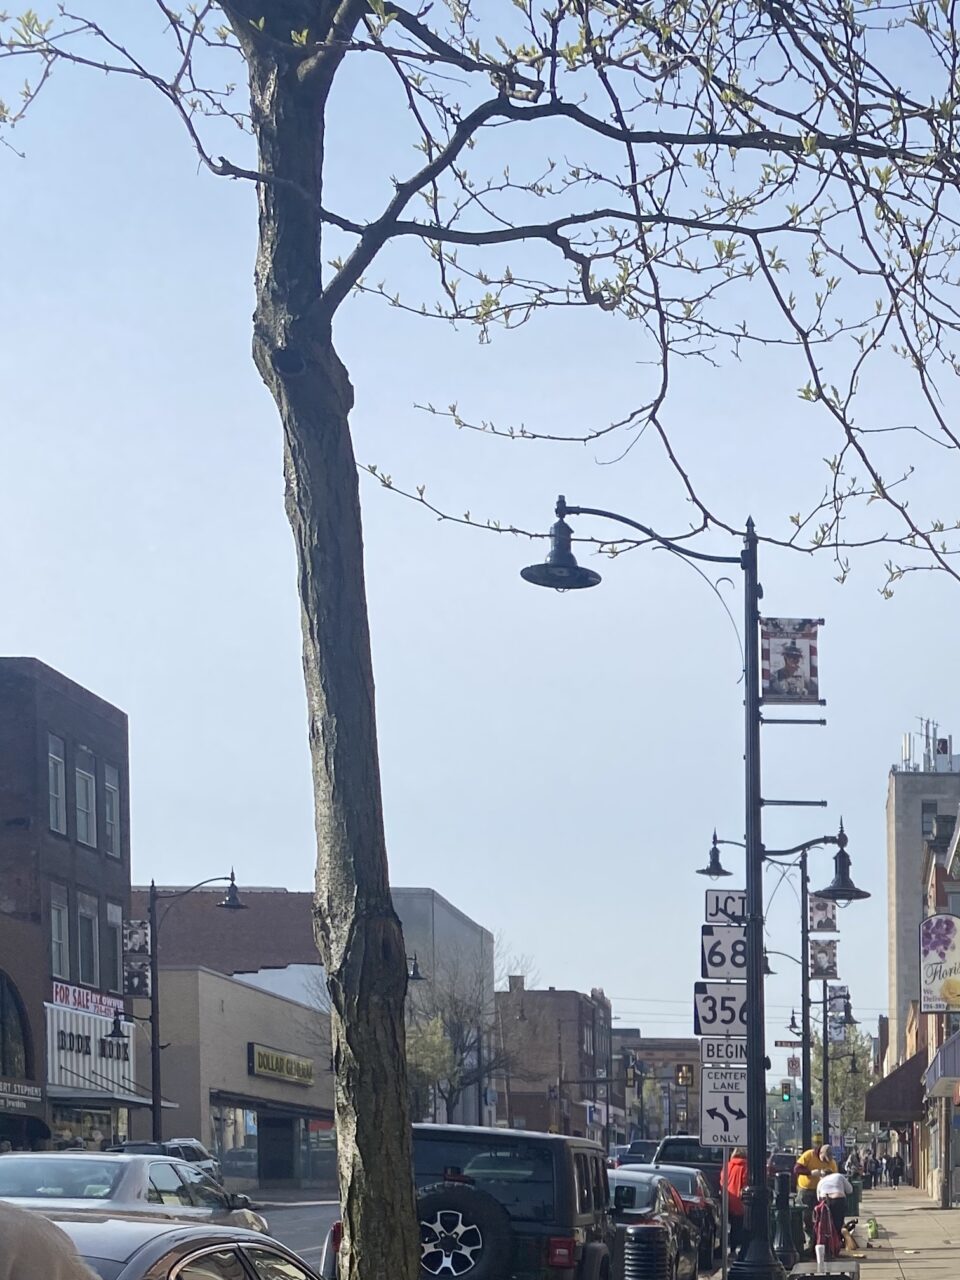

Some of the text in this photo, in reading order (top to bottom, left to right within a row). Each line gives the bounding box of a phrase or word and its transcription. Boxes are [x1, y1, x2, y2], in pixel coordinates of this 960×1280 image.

[709, 896, 747, 918] JCT
[708, 940, 747, 968] 68
[54, 982, 91, 1009] FOR SALE
[707, 1043, 748, 1059] BEGIN
[257, 1051, 285, 1074] DOLLAR
[707, 1071, 747, 1080] CENTER
[713, 1082, 740, 1090] LANE
[712, 1134, 740, 1143] ONLY
